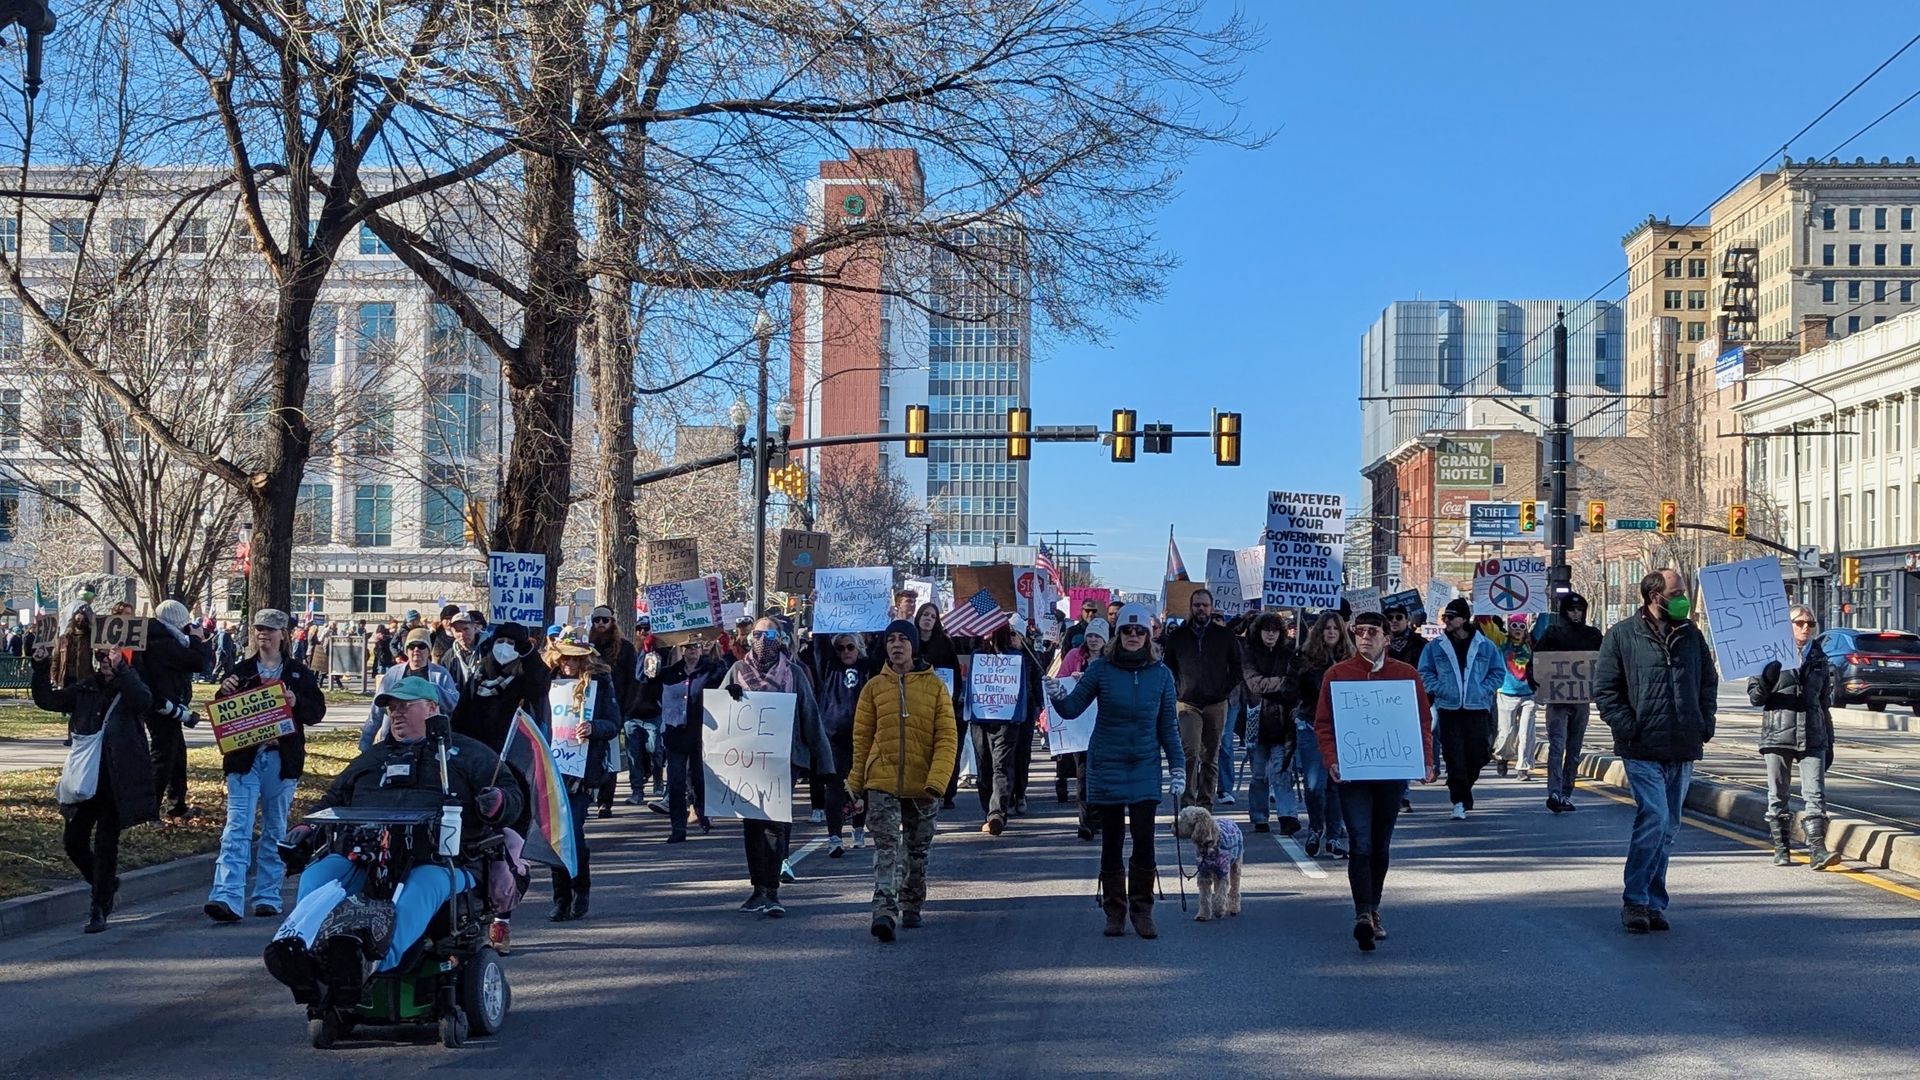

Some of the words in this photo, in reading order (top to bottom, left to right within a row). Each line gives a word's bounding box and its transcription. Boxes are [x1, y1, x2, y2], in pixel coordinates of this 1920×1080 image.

[1446, 442, 1484, 454] NEW
[1439, 455, 1490, 467] GRAND
[1440, 468, 1487, 480] HOTEL
[1272, 491, 1341, 506] WHATEVER
[1270, 504, 1296, 516] YOU
[1300, 506, 1342, 519] ALLOW
[1288, 517, 1324, 530] YOUR
[1621, 520, 1640, 528] STATE
[785, 533, 823, 550] MELT
[1266, 530, 1345, 544] GOVERNMENT
[650, 542, 665, 554] DO
[669, 539, 694, 550] NOT
[1272, 542, 1288, 554] TO
[1293, 543, 1312, 555] DO
[1315, 545, 1332, 557] TO
[650, 549, 694, 564] REJECT
[1275, 555, 1328, 568] OTHERS
[489, 556, 516, 573] The
[518, 558, 543, 576] Only
[1473, 559, 1500, 579] NO
[1269, 567, 1301, 580] THEY
[1305, 569, 1334, 581] WILL
[523, 576, 545, 589] NEED
[645, 583, 682, 593] IMPEACH
[820, 576, 832, 590] NO
[1263, 580, 1340, 595] EVENTUALLY
[1706, 564, 1779, 602] ICE
[648, 590, 685, 600] CONVICT
[1216, 586, 1238, 595] FUC
[653, 597, 688, 607] REMOVE
[1214, 600, 1249, 611] RUMP
[1267, 594, 1285, 605] DO
[1289, 595, 1305, 607] TO
[1309, 596, 1334, 608] YOU
[493, 604, 507, 620] MY
[650, 606, 674, 616] LYING
[681, 601, 710, 612] TRUMP
[827, 605, 871, 620] Abolish
[1710, 606, 1743, 633] IS
[1743, 597, 1788, 630] THE
[651, 616, 668, 625] AND
[672, 612, 686, 621] HIS
[651, 622, 675, 632] LYING
[979, 656, 1017, 667] SCHOOL
[1717, 639, 1795, 671] TALIBAN
[974, 674, 1017, 684] EDUCATION
[217, 700, 236, 713] NO
[241, 690, 274, 706] I.C.E.
[972, 693, 1018, 704] DEPORTATION
[1340, 691, 1370, 710] It's
[1370, 689, 1403, 708] Time
[220, 700, 276, 722] ALLOWED
[728, 704, 776, 736] ICE
[1363, 714, 1380, 726] to
[258, 725, 276, 734] OUT
[252, 732, 276, 743] UTAH
[552, 748, 576, 760] OW
[724, 748, 774, 770] OUT
[722, 776, 782, 806] NOW!
